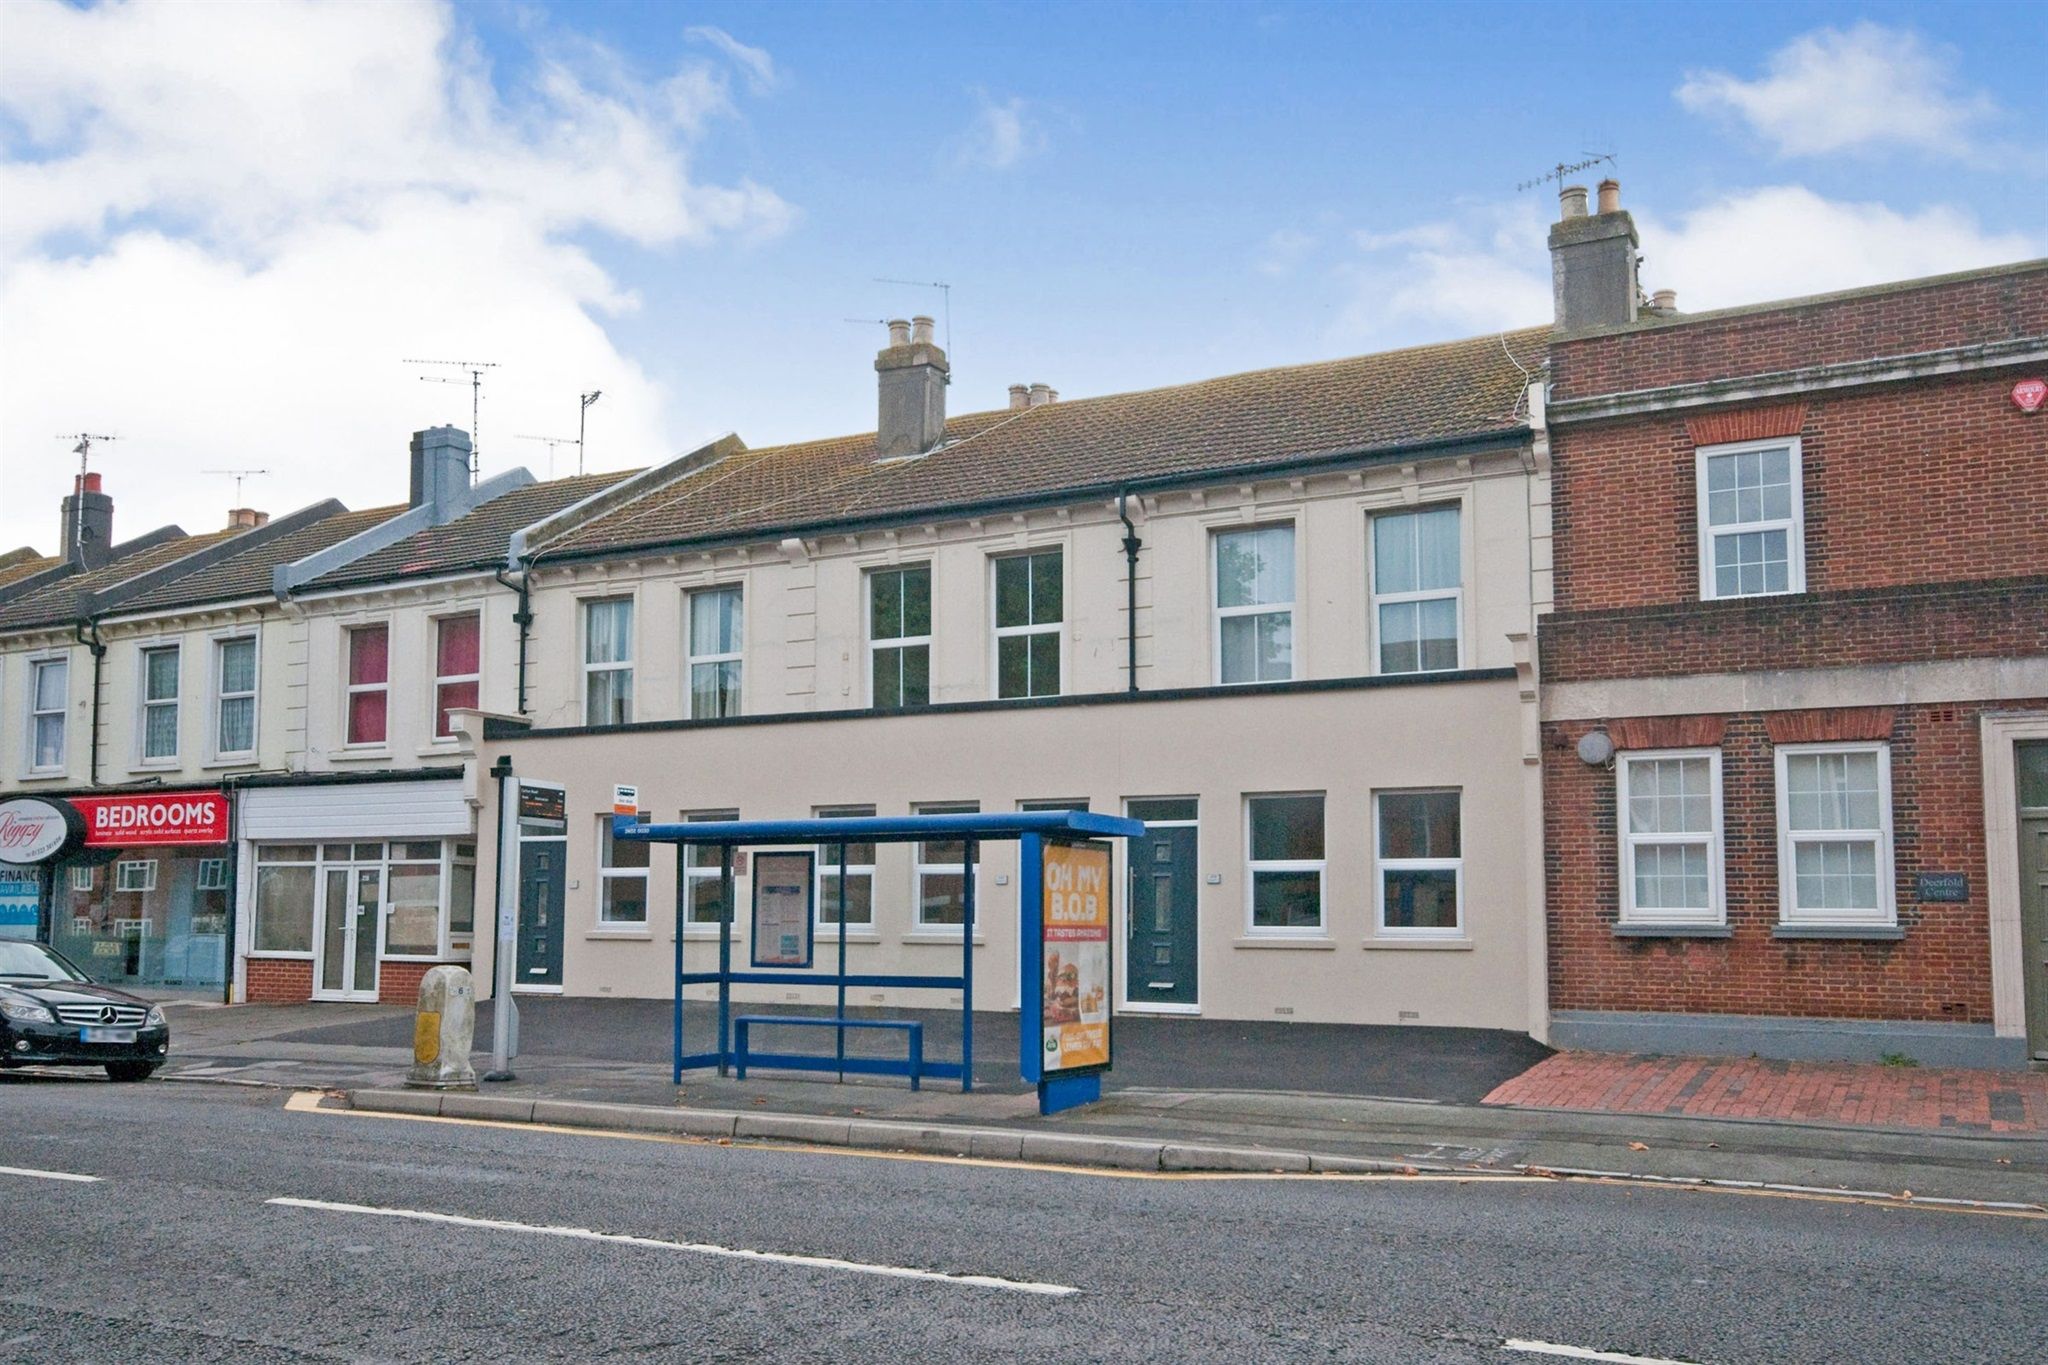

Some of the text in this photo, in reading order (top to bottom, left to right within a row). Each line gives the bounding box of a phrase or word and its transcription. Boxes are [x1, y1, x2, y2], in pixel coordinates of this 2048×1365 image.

[95, 801, 216, 828] BEDROOMS
[1047, 862, 1103, 893] OH MY
[1925, 887, 1959, 897] Centre
